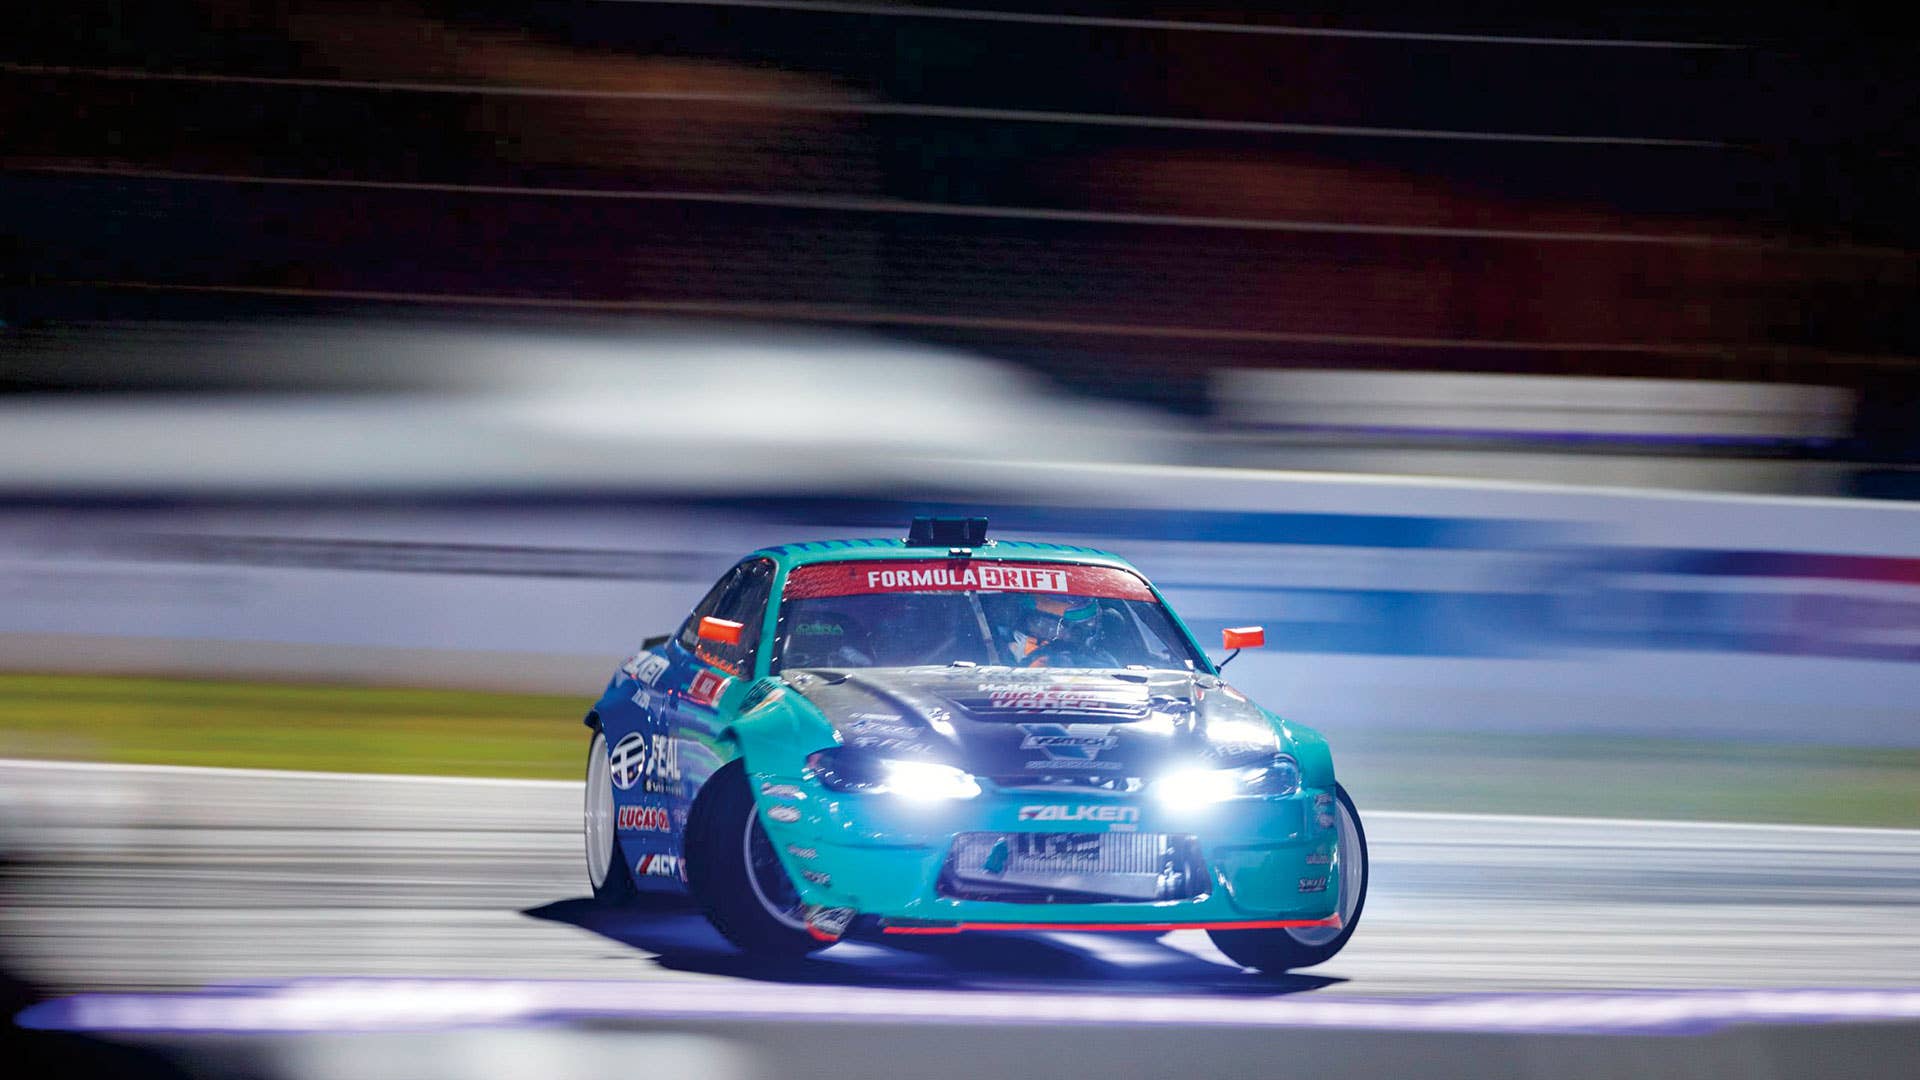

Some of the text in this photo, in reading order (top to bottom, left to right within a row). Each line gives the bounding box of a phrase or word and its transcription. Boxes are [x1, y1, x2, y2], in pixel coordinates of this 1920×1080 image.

[867, 568, 1063, 591] FORMULA DRIFT
[618, 805, 658, 831] LUCAS
[1018, 805, 1139, 822] FALKEN
